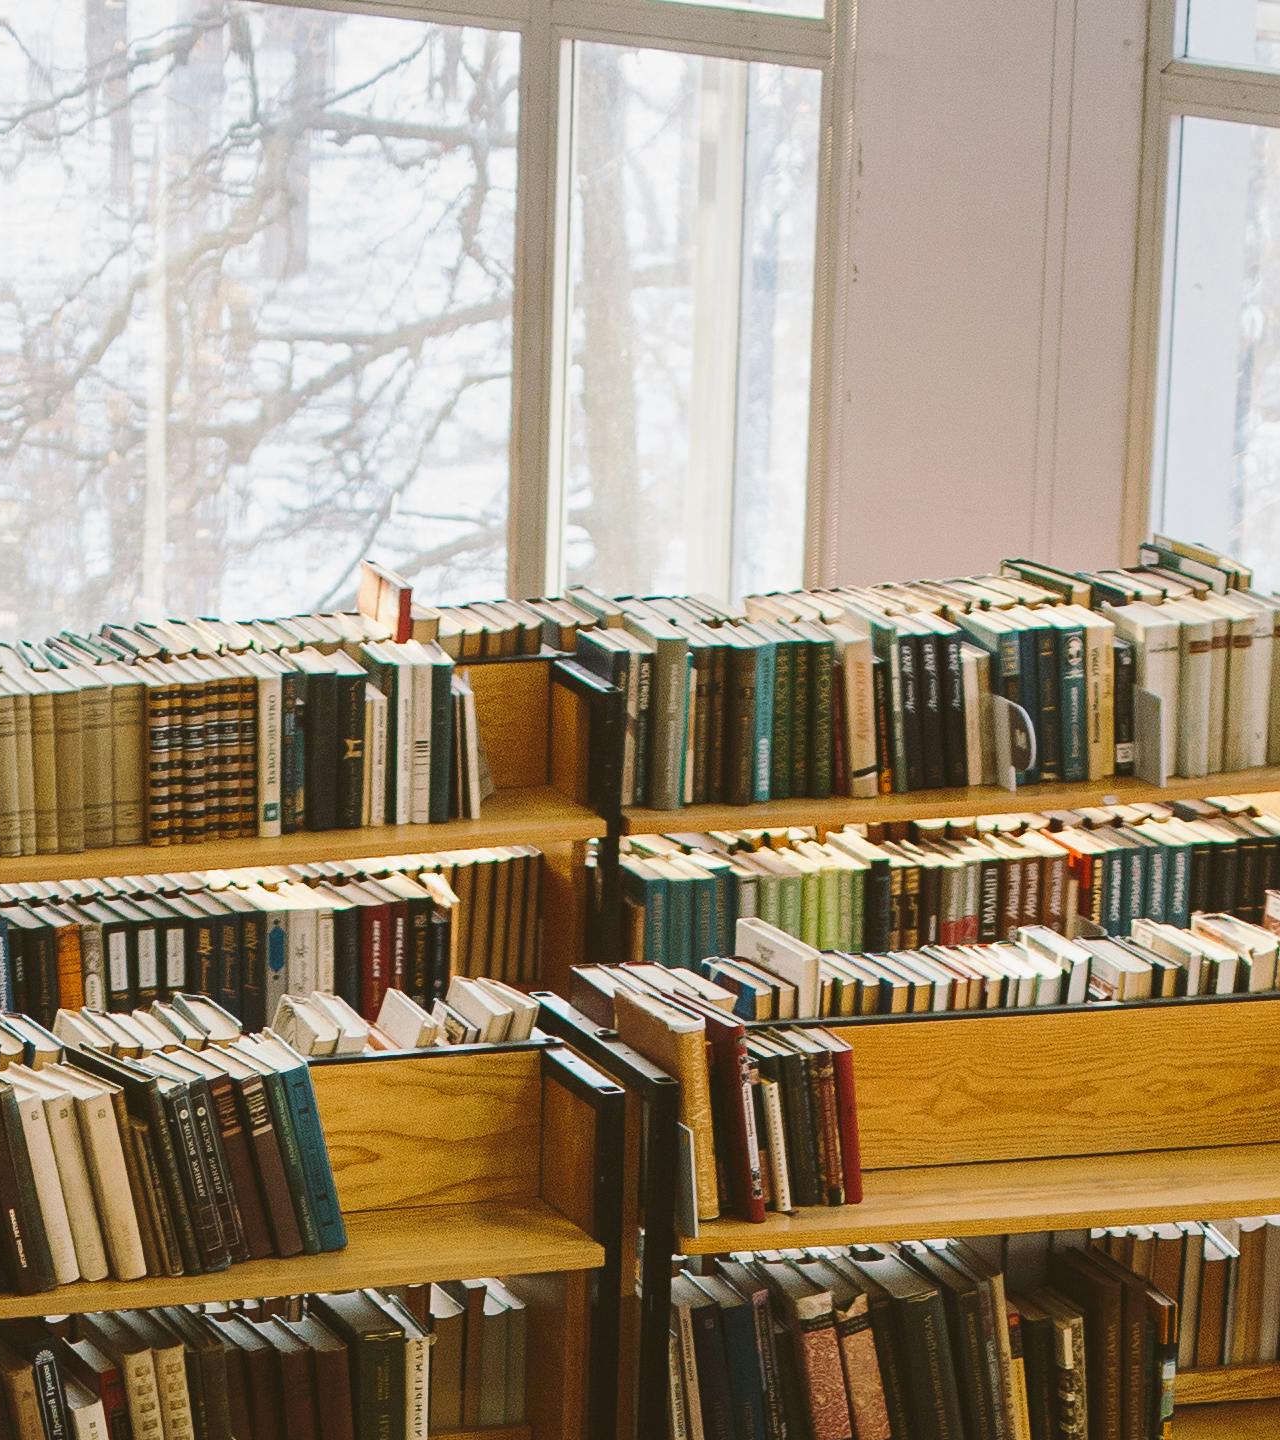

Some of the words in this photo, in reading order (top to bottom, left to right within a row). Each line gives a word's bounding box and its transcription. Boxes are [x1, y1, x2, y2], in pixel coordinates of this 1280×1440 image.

[182, 1122, 197, 1156] ВОСТОК
[200, 1120, 214, 1152] ВОСТОК
[191, 1159, 207, 1198] ДРЕВНИЙ
[208, 1157, 224, 1194] ДРЕВНИЙ
[43, 1364, 57, 1397] Греции
[49, 1398, 64, 1436] Древней
